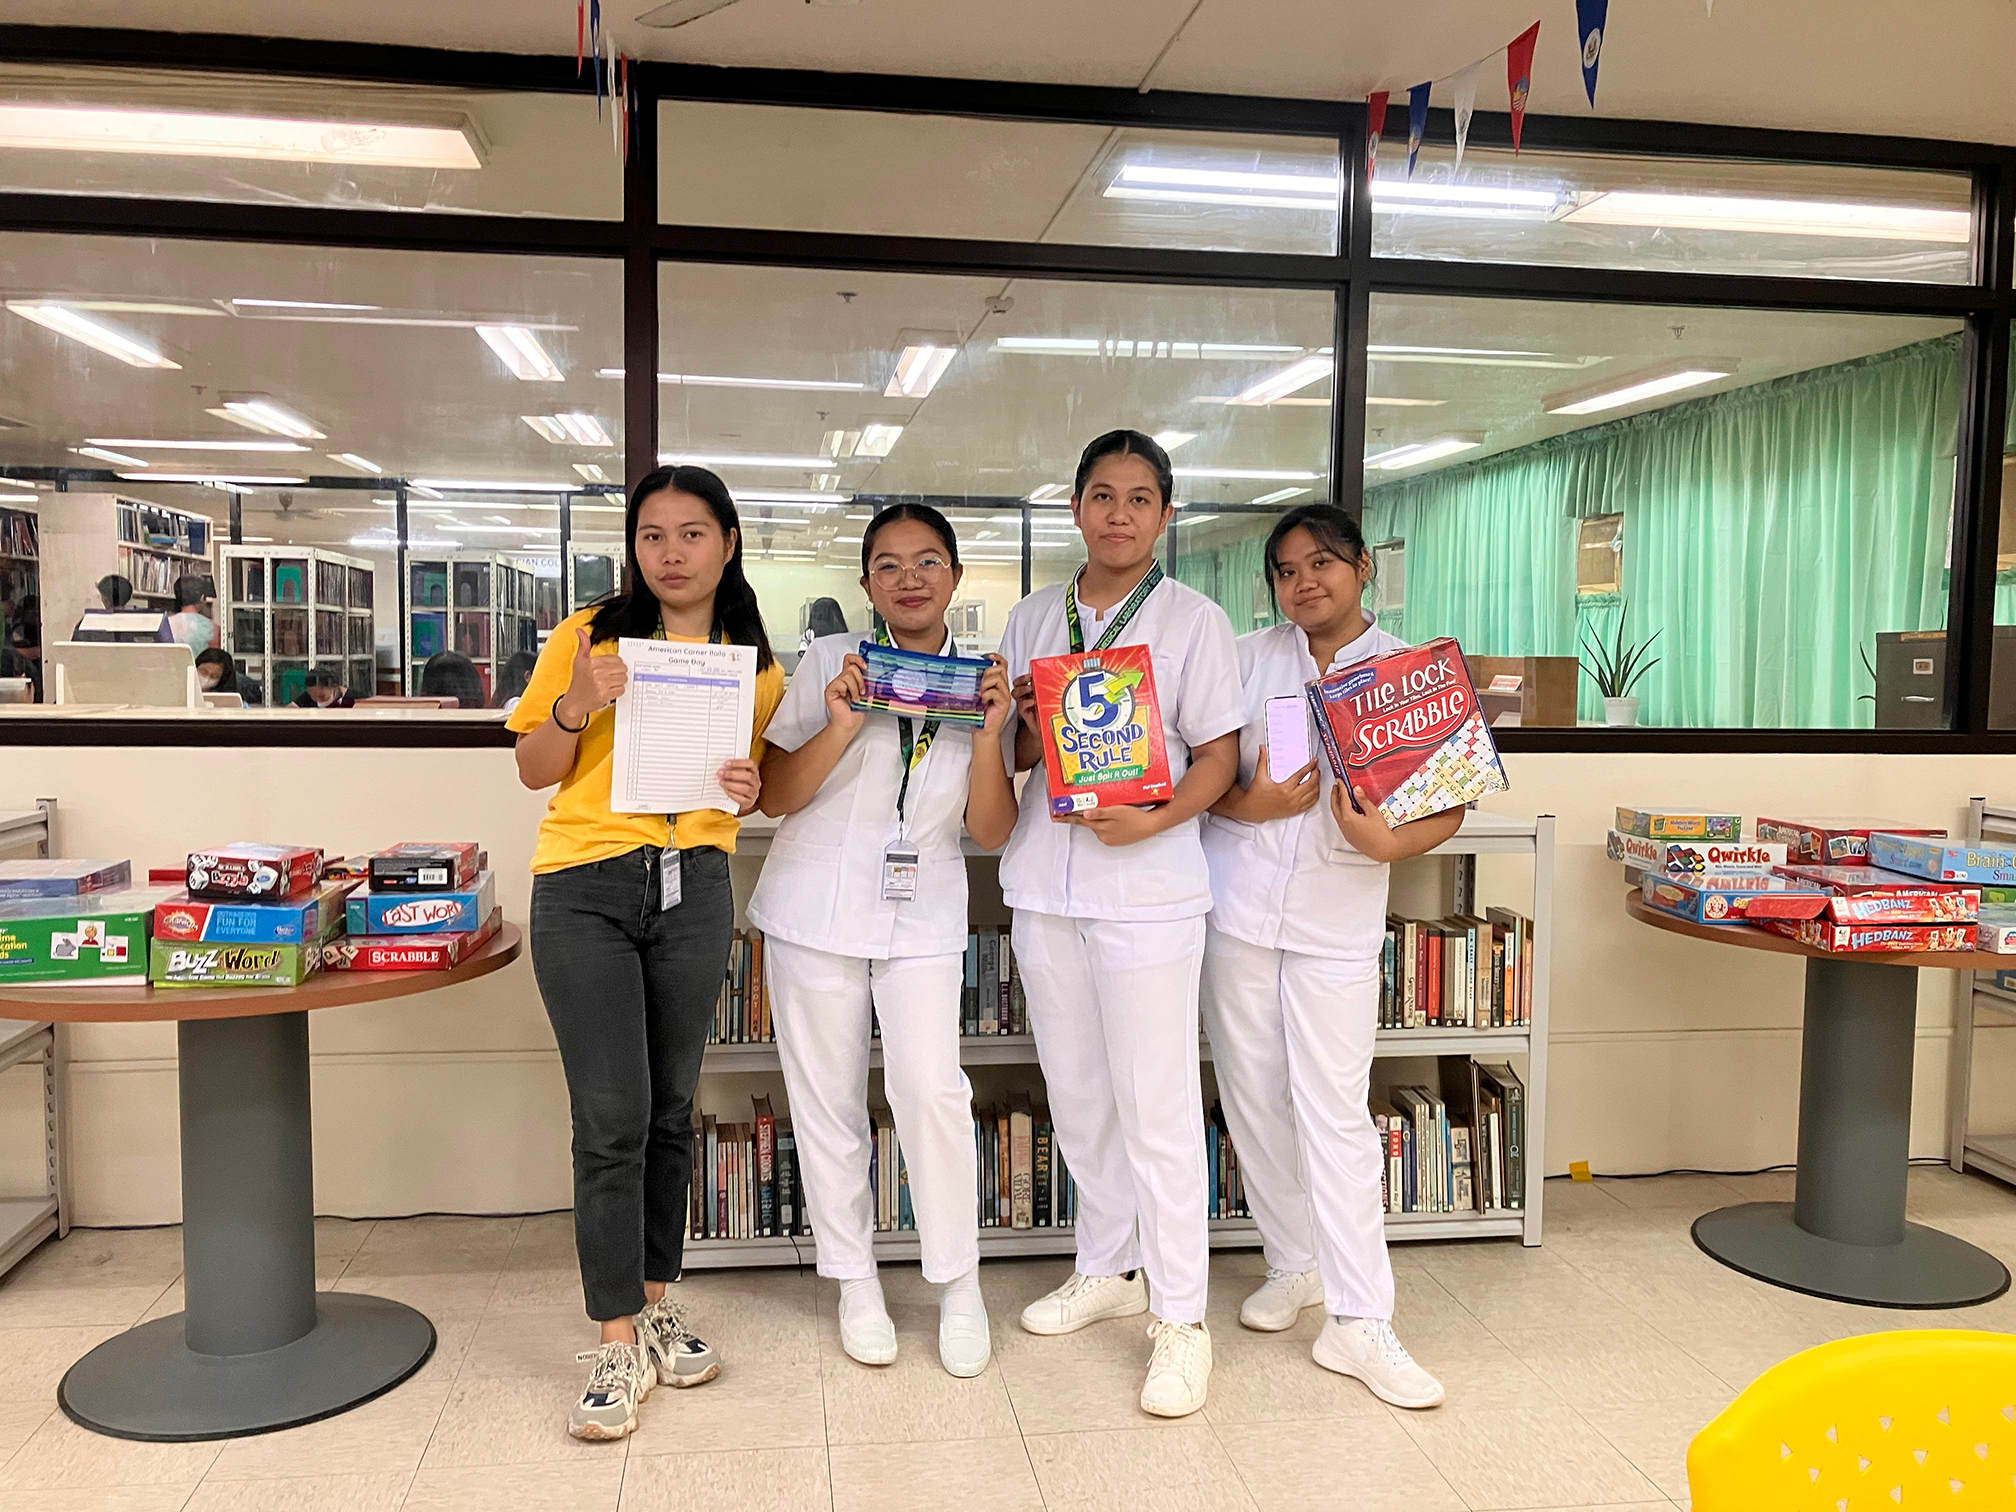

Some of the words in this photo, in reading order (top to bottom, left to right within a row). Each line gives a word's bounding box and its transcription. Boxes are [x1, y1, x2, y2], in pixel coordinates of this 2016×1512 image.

[1119, 583, 1151, 625] LABORATORY
[647, 645, 682, 655] American
[683, 647, 708, 656] Corner
[668, 656, 690, 665] Game
[691, 658, 706, 667] Day
[1401, 657, 1456, 697] LOCK
[1078, 671, 1119, 729] 5
[1061, 723, 1144, 754] SECOND
[1079, 746, 1133, 773] RULE
[1626, 837, 1658, 861] Qwirkle
[1707, 846, 1771, 864] Qwirkle
[1966, 851, 2005, 869] Brain
[423, 901, 464, 922] WORD
[1851, 898, 1913, 921] HEDBANZ
[215, 926, 256, 936] EVERYONE
[216, 918, 236, 927] FUN
[240, 918, 257, 928] FOR
[1851, 930, 1913, 950] HEDBANZ
[223, 947, 281, 971] Word
[372, 951, 440, 963] SCRABBLE
[1037, 1136, 1049, 1172] BEAR
